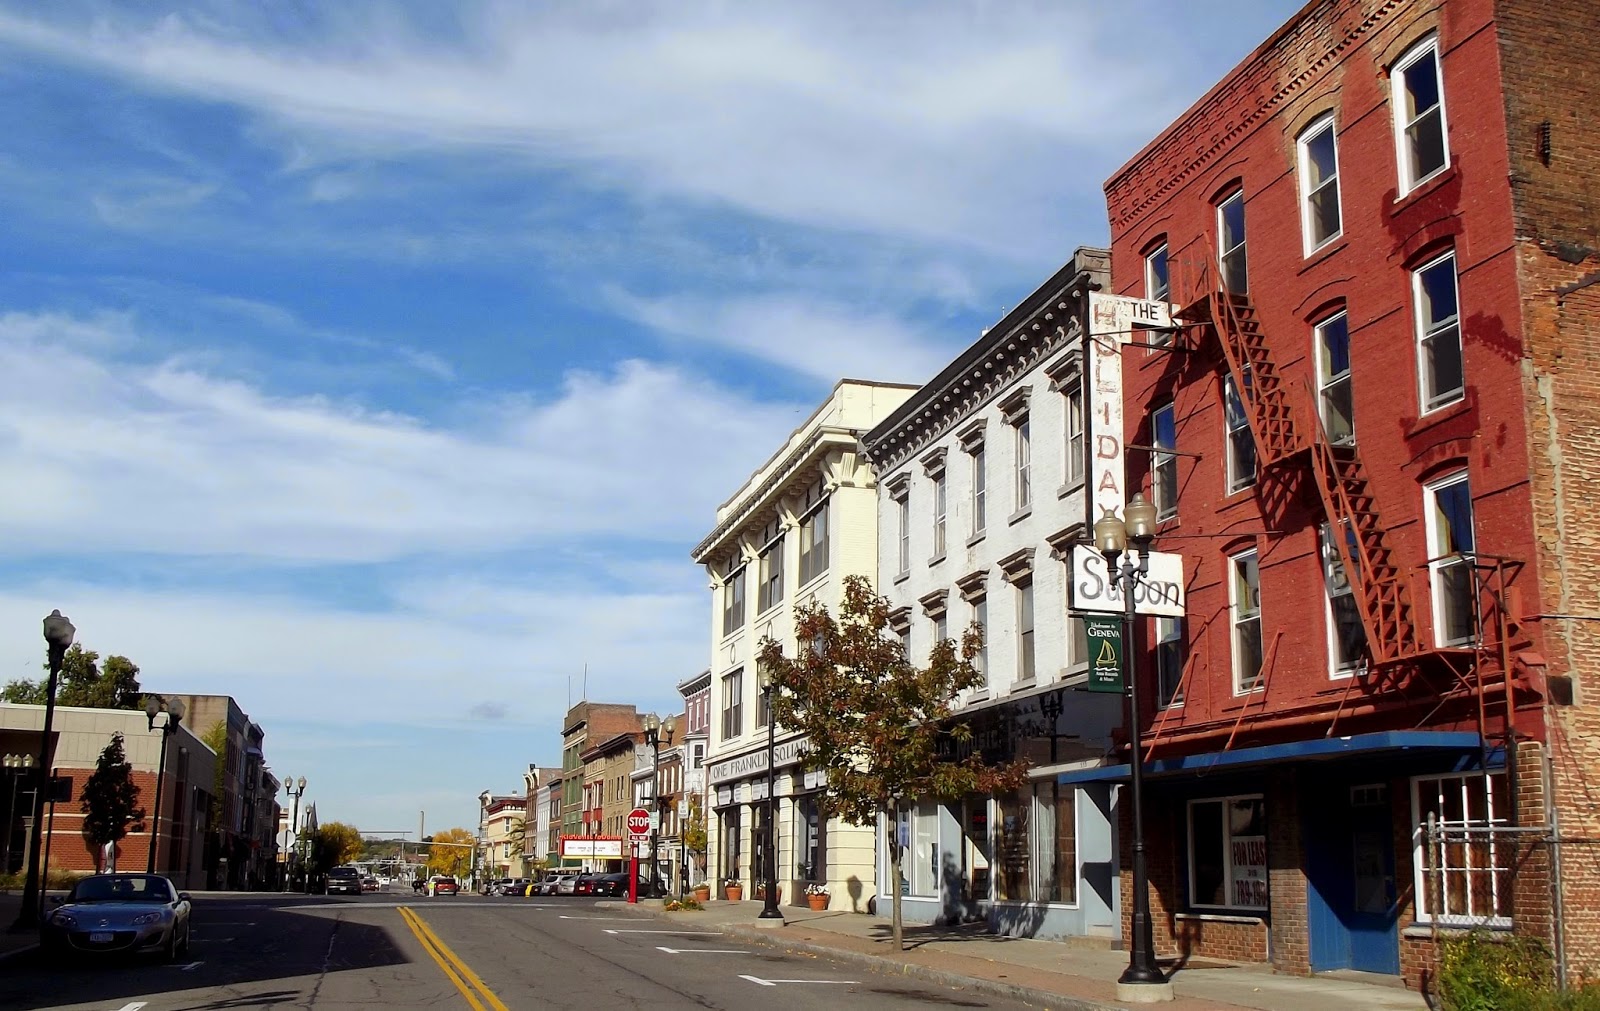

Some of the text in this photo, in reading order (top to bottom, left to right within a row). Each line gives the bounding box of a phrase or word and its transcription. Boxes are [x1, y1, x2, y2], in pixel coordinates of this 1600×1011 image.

[1131, 302, 1159, 320] THE
[1079, 555, 1180, 606] Saoon
[1088, 627, 1120, 638] GENEVA
[713, 763, 728, 779] ONE
[731, 752, 769, 773] FRANKLIN
[629, 817, 650, 826] STOP
[1232, 841, 1266, 866] FOR LEAS
